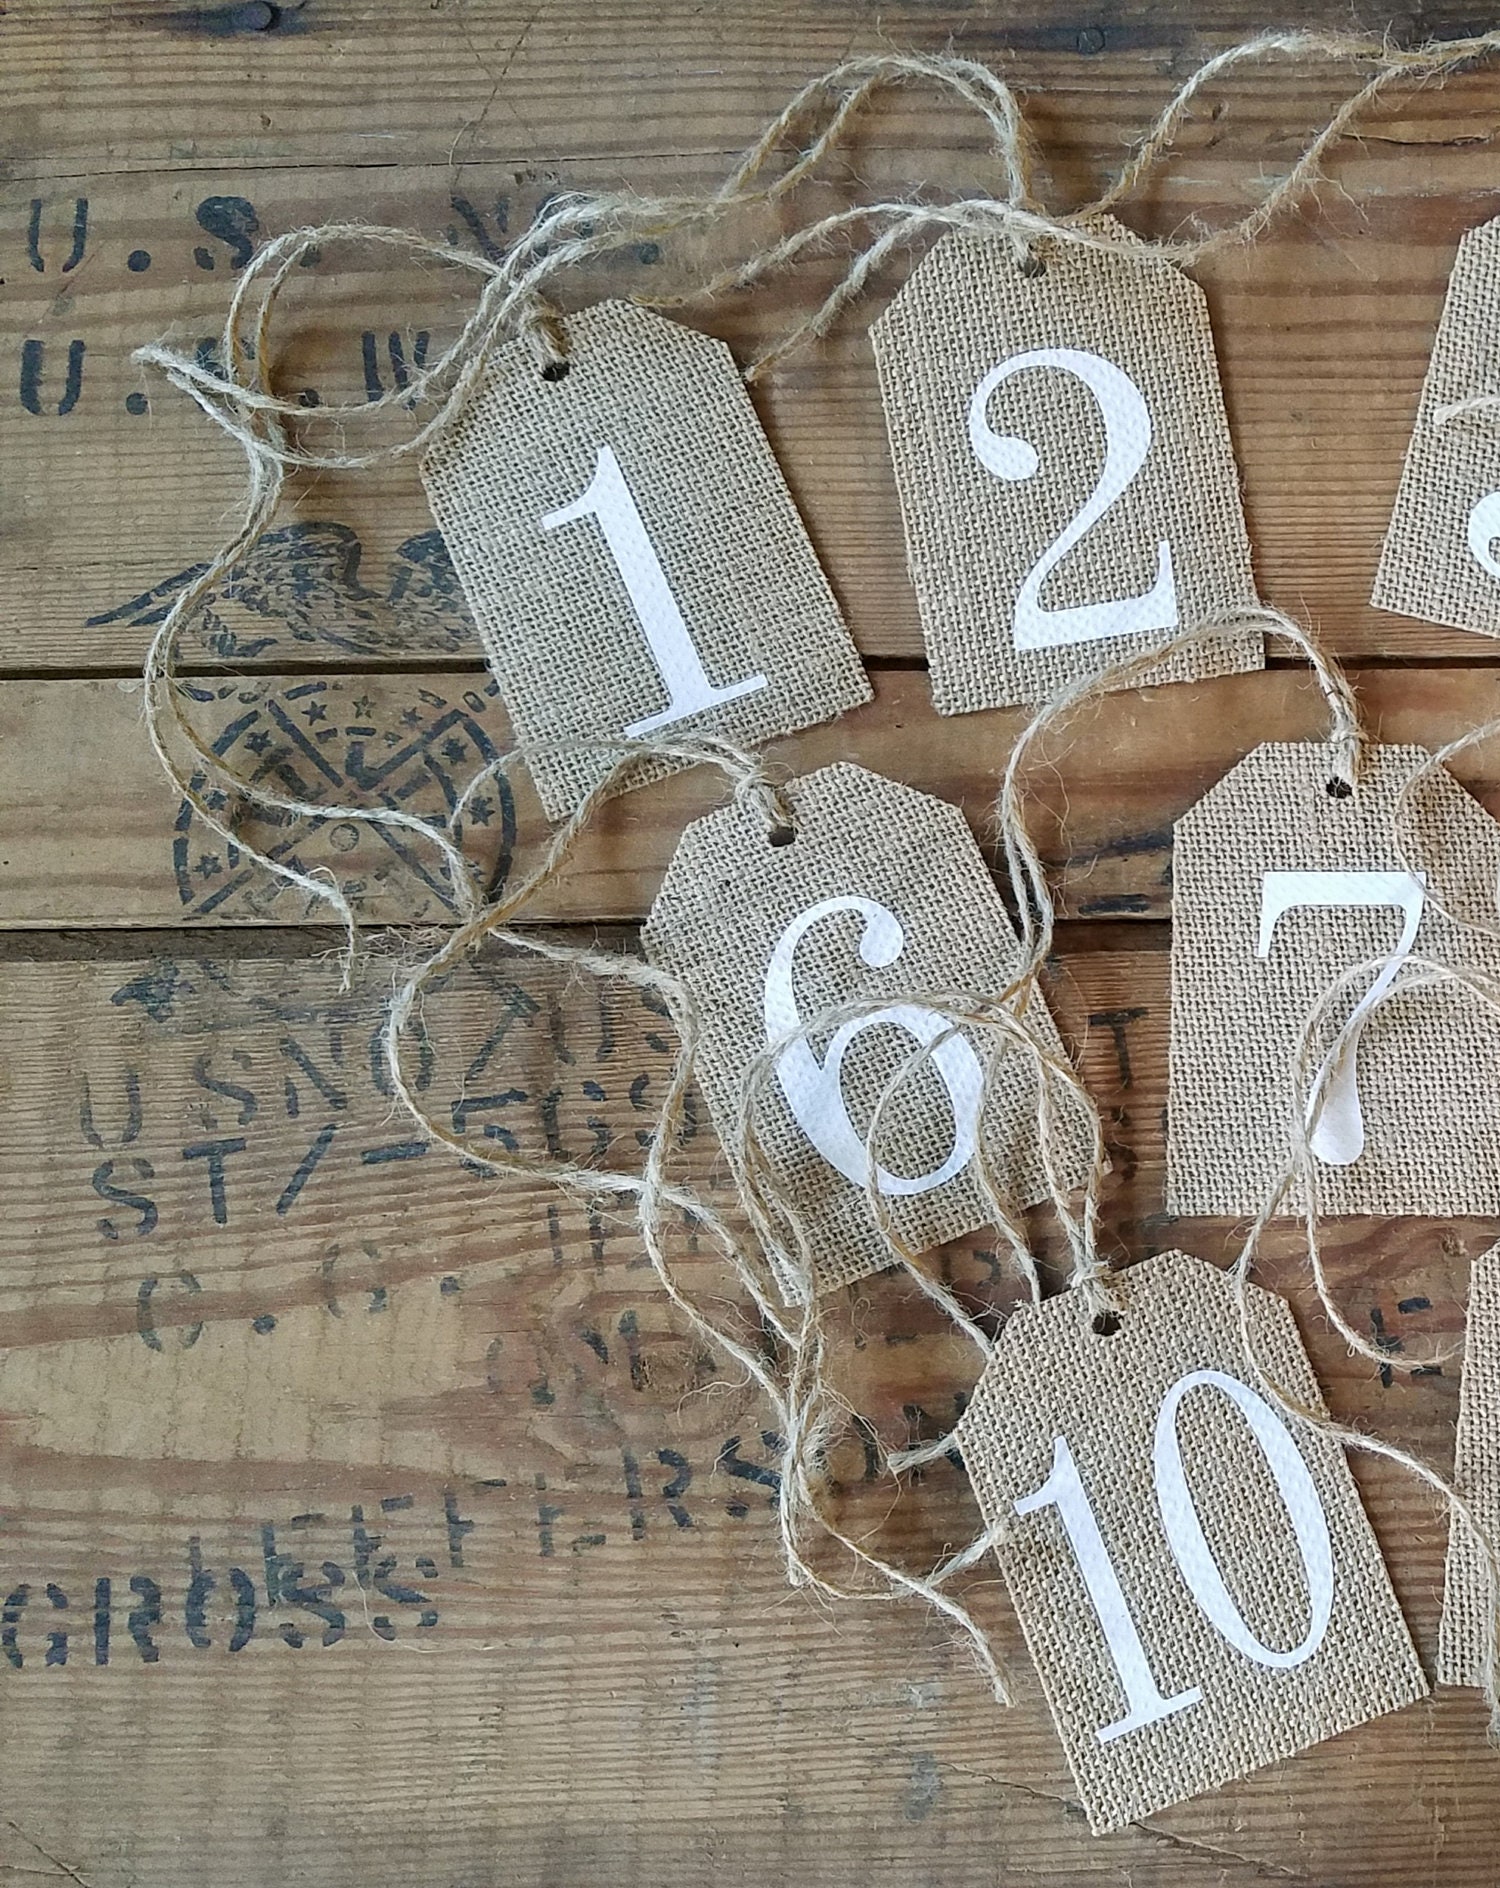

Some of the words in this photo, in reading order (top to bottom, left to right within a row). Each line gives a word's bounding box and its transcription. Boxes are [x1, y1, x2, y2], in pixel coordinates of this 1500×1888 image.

[541, 445, 768, 738] 1
[968, 346, 1179, 652] 2
[762, 893, 984, 1199] 6
[1257, 871, 1426, 1166] 7
[1012, 1368, 1336, 1744] 10
